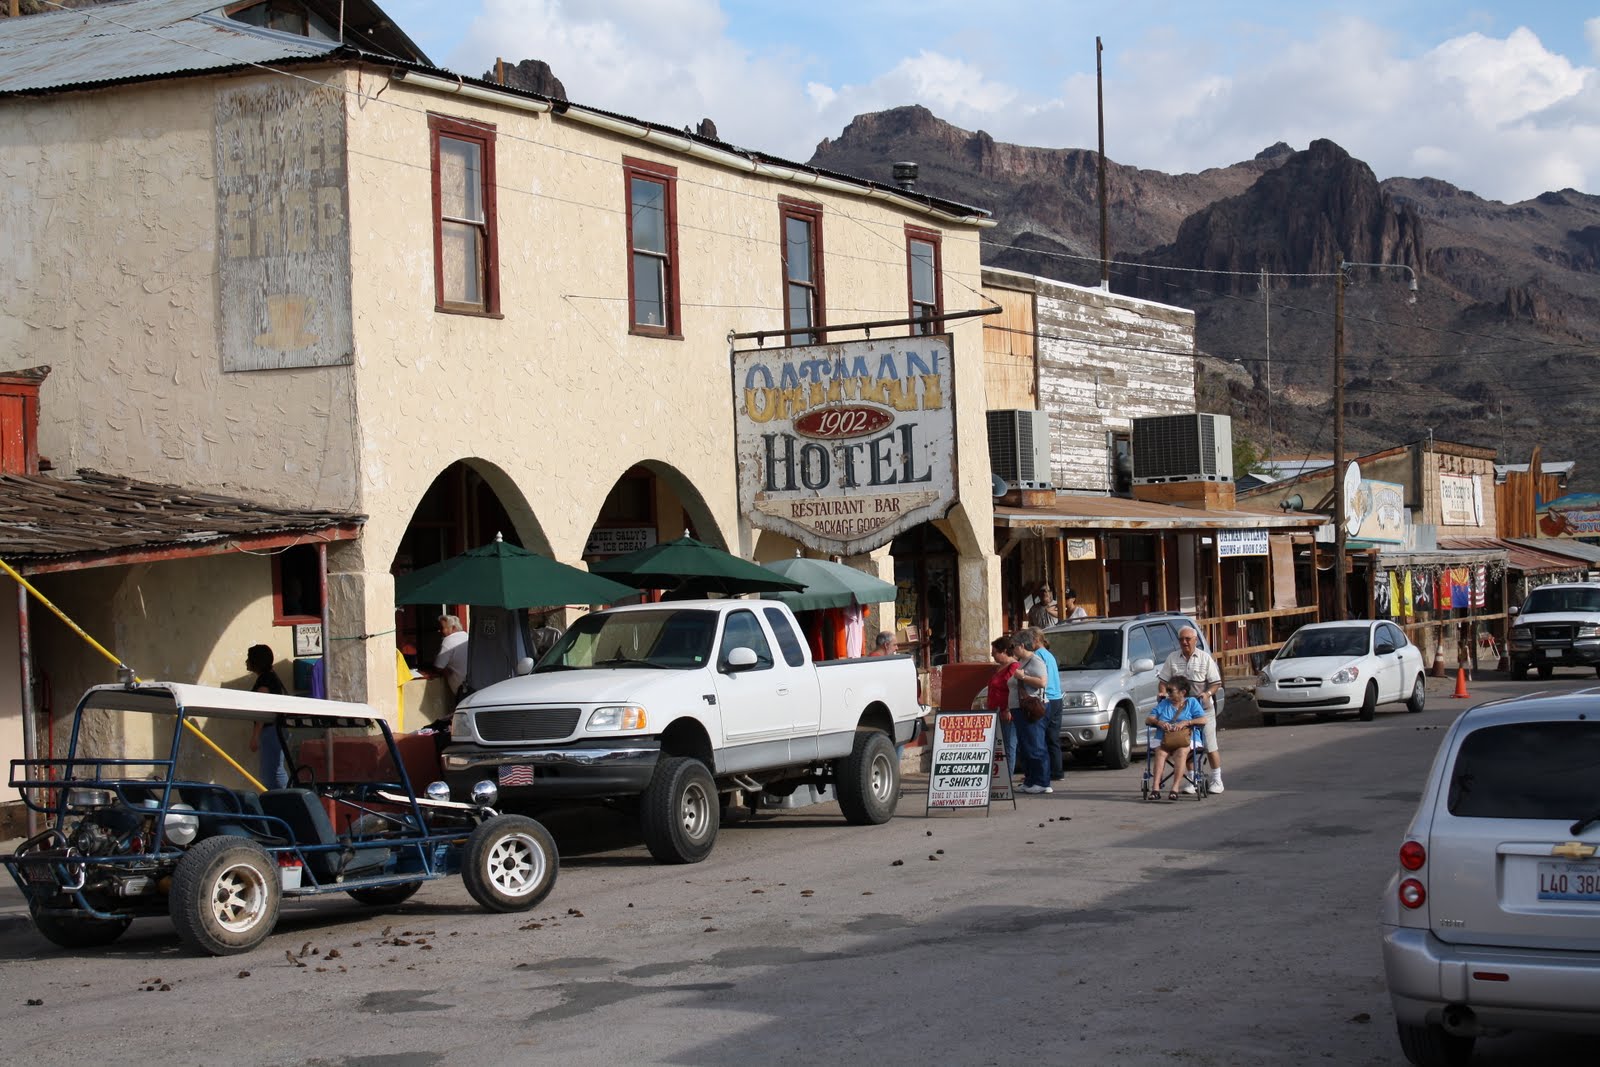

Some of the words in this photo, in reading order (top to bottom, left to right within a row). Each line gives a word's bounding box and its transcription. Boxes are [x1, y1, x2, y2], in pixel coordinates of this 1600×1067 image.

[743, 350, 944, 423] OATMAN
[815, 411, 868, 436] 1902
[761, 423, 932, 492] HOTEL
[791, 500, 866, 518] RESTAURANT
[875, 498, 900, 513] BAR
[814, 518, 855, 535] PACKAGE
[615, 530, 647, 541] SALLY'S
[602, 542, 617, 552] ICE
[618, 541, 647, 551] CREAM
[939, 715, 993, 729] OATMAN
[943, 729, 986, 743] HOTEL
[939, 752, 988, 761] RESTAURANT
[939, 765, 950, 774] ICE
[939, 777, 982, 787] T-SHIRTS
[1540, 874, 1568, 894] L40
